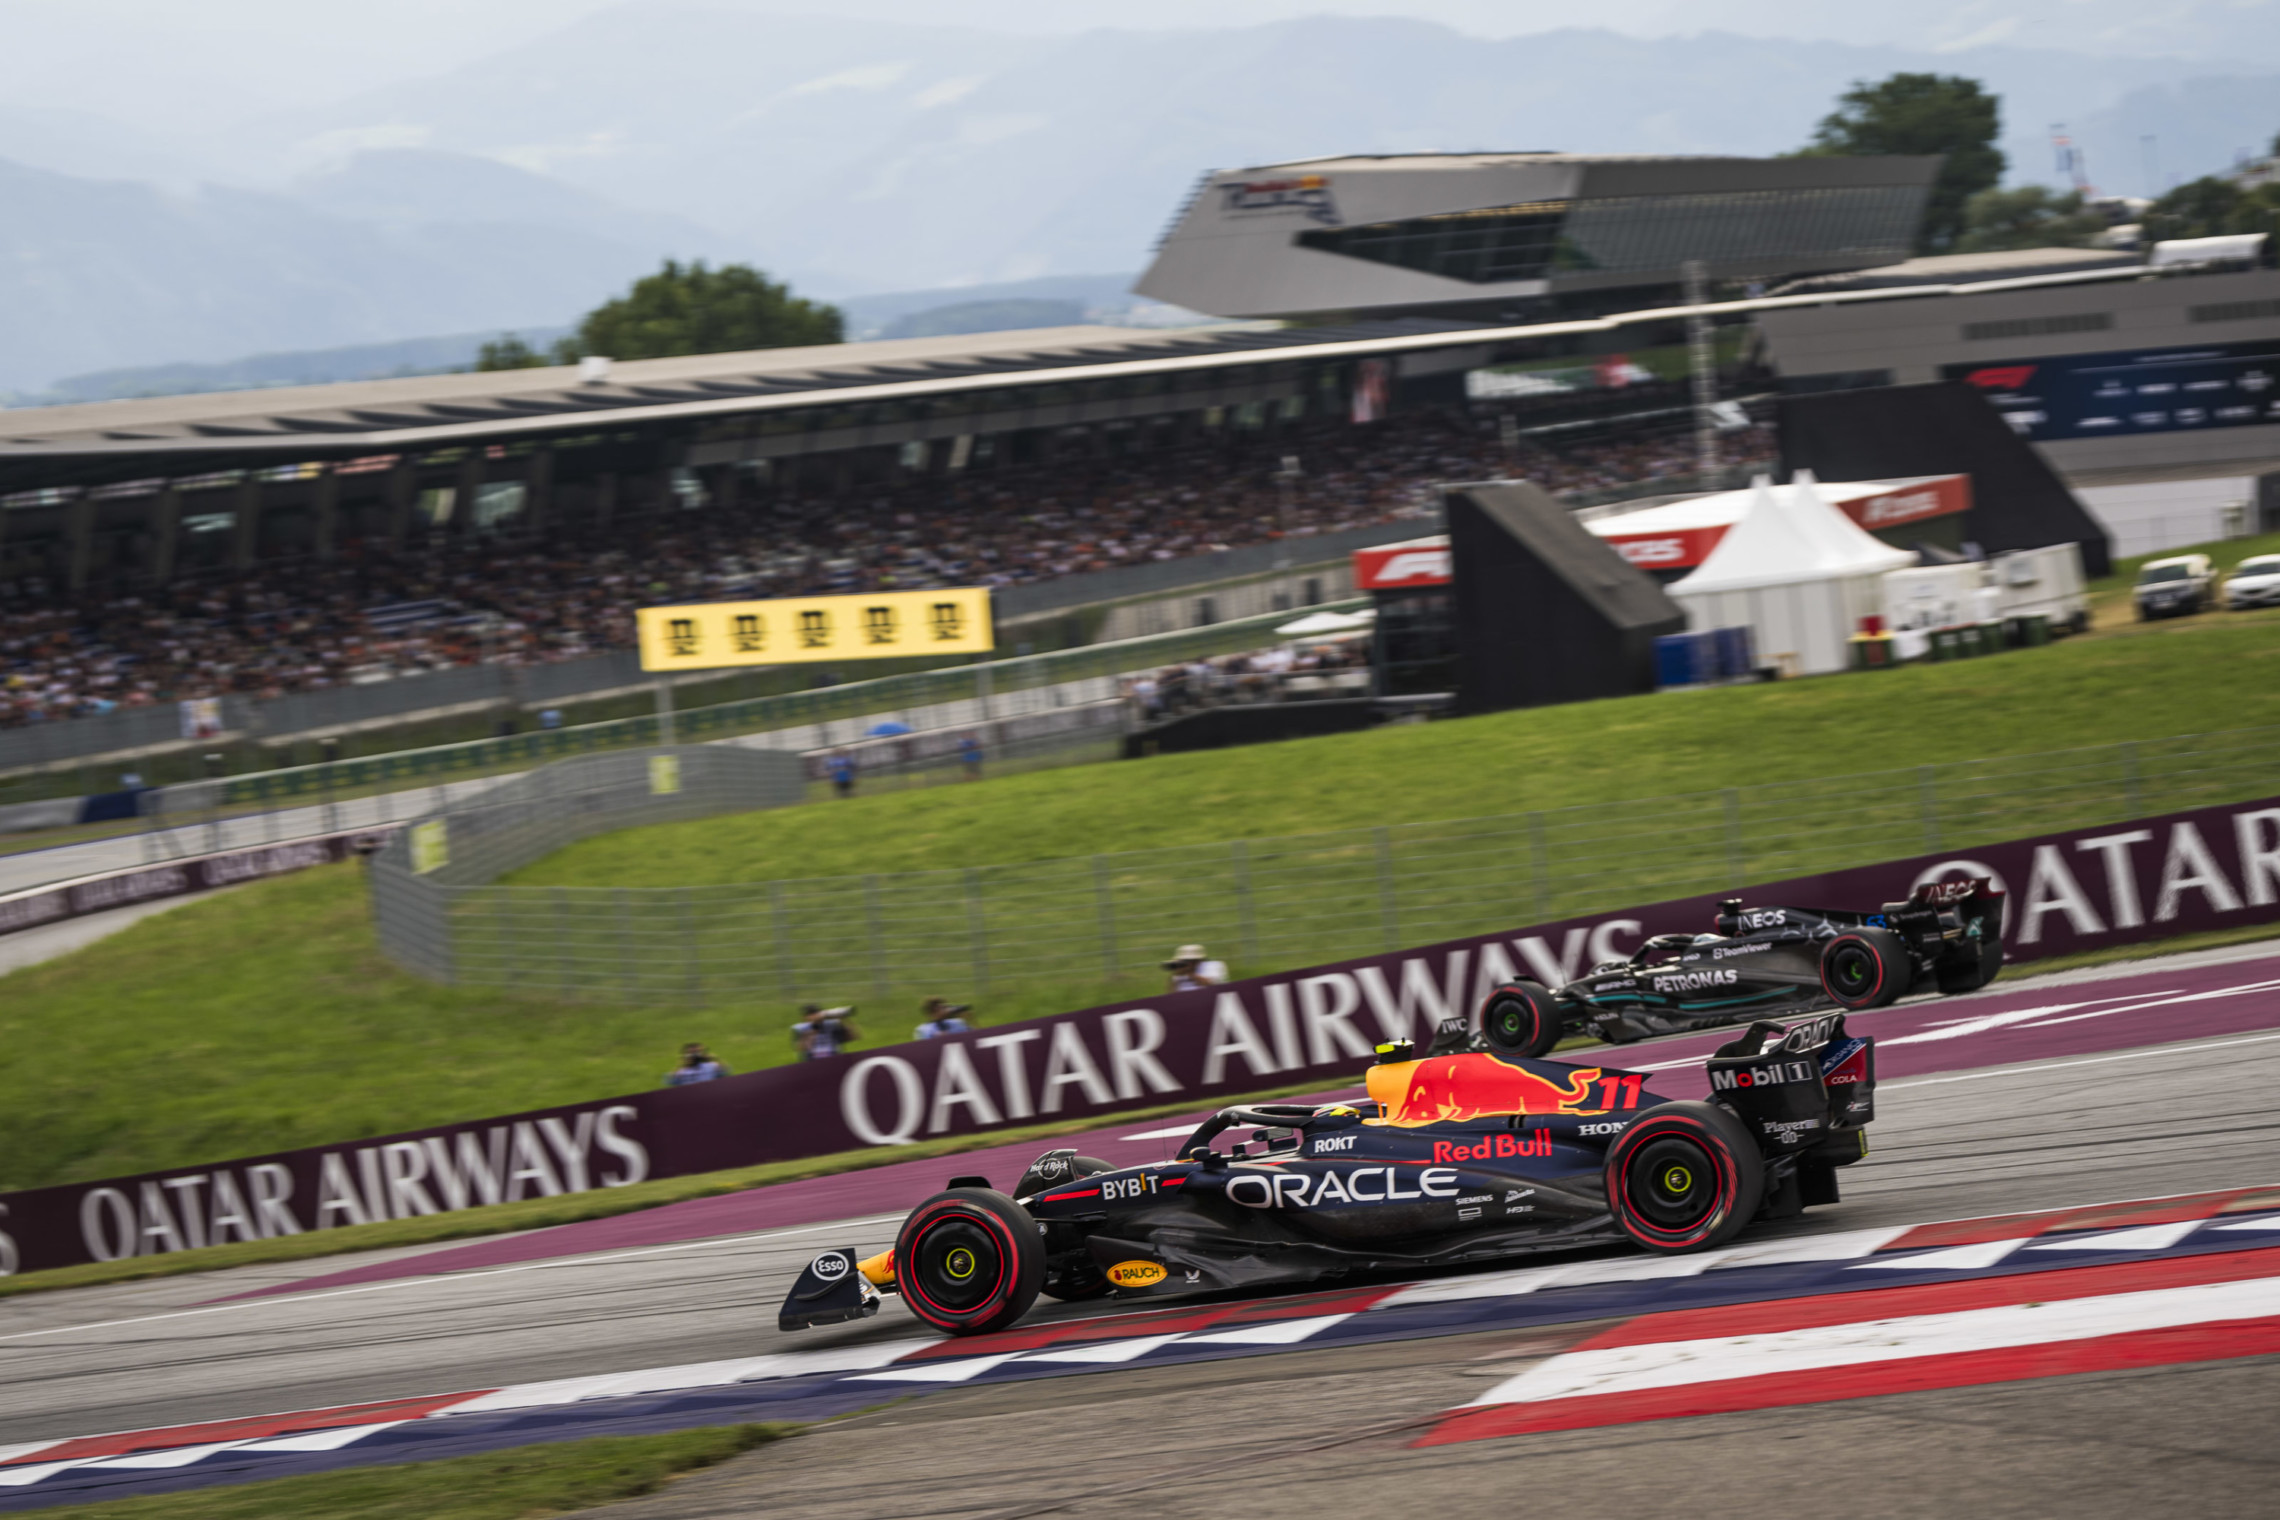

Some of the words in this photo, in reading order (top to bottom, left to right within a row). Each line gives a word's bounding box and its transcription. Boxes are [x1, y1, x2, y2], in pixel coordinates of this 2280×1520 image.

[1738, 910, 1786, 930] INEOS
[1654, 970, 1738, 992] PETRONAS
[1442, 1018, 1468, 1034] IWC
[841, 1009, 1184, 1146] QATAR
[1712, 1064, 1785, 1091] Mobil
[1831, 1075, 1857, 1084] COLA
[1597, 1074, 1642, 1110] 11
[1314, 1136, 1357, 1153] ROKT
[1434, 1135, 1491, 1163] Red
[1496, 1128, 1552, 1158] Bull
[1030, 1163, 1049, 1172] Hard
[1050, 1160, 1068, 1171] Rock
[81, 1163, 301, 1263] QATAR
[317, 1105, 650, 1228] AIRWAYS
[1102, 1173, 1159, 1200] BYBIT
[1226, 1167, 1460, 1208] ORACLE
[1455, 1194, 1493, 1205] SIEMENS
[1122, 1267, 1159, 1279] RAUCH
